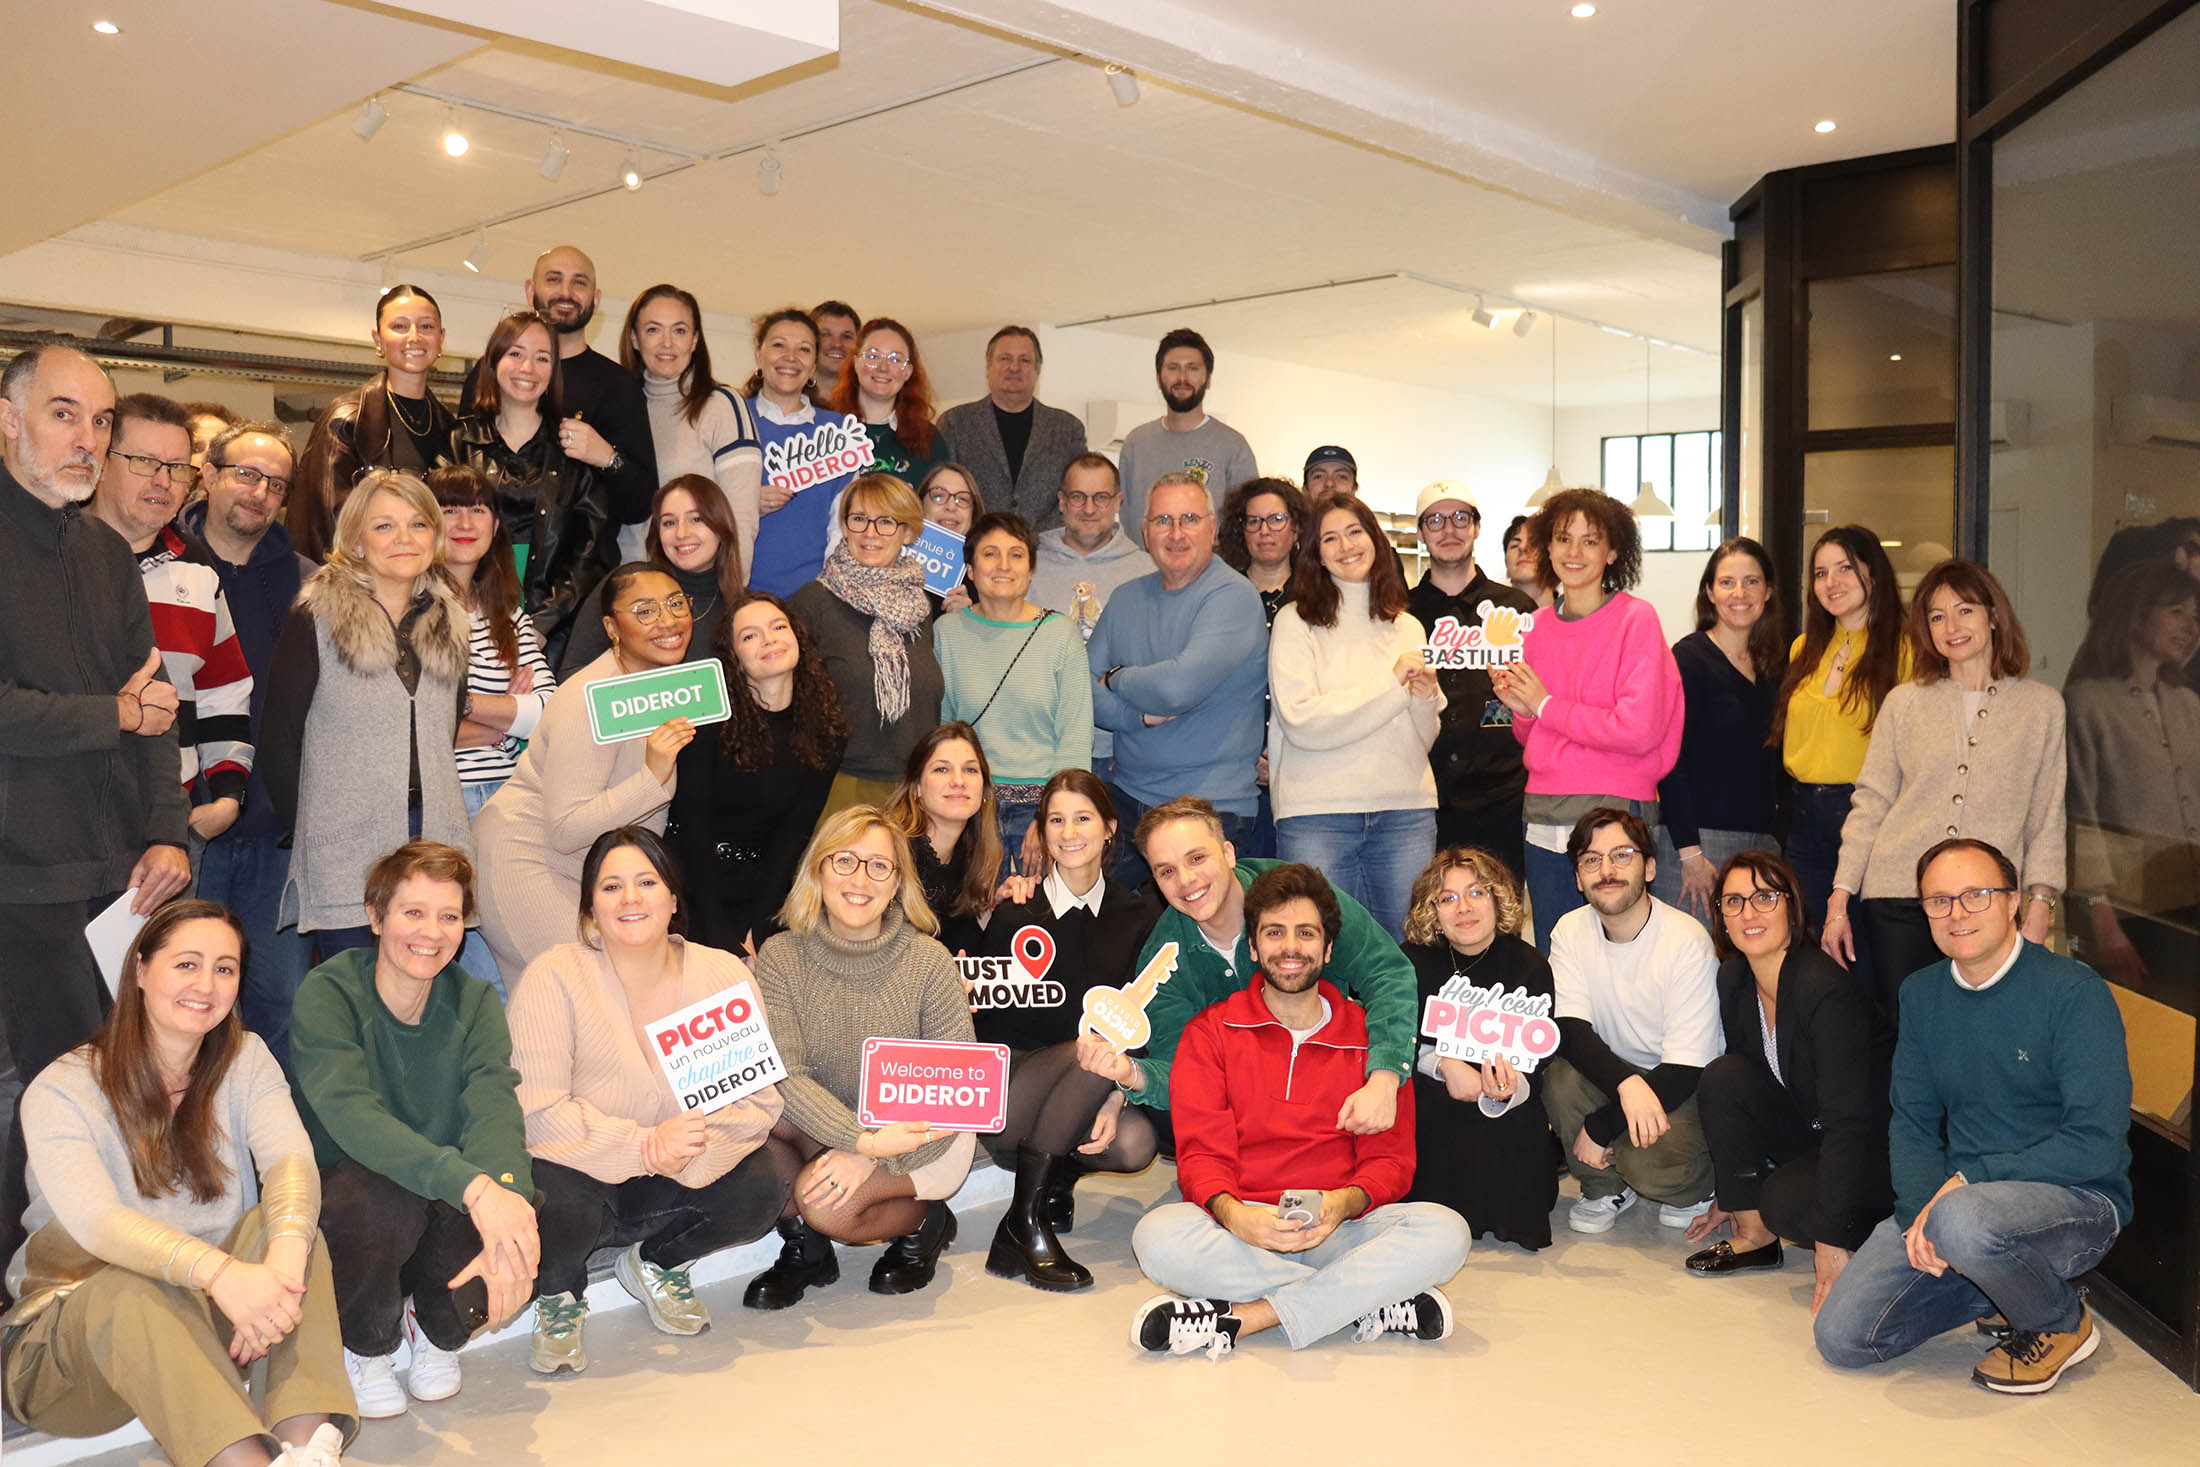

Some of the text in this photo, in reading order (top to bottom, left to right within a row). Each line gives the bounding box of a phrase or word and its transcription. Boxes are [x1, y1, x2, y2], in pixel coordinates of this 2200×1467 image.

[772, 443, 871, 489] DIDEROT
[786, 427, 847, 470] Hello
[1422, 649, 1519, 666] BASTILLE
[1433, 620, 1482, 661] Bye
[611, 684, 703, 719] DIDEROT
[955, 959, 1012, 980] UST
[968, 983, 1064, 1006] MOVED
[1442, 979, 1500, 1017] Hey!
[656, 998, 752, 1057] PICTO
[1093, 1001, 1137, 1041] PICTO
[1425, 1000, 1556, 1055] PICTO
[669, 1022, 761, 1071] un nouveau
[678, 1041, 769, 1091] chapitre à
[1440, 1041, 1535, 1069] DIDEOT
[683, 1056, 777, 1110] DIDEROT!
[880, 1061, 985, 1081] Welcome to
[879, 1082, 991, 1107] DIDEROT
